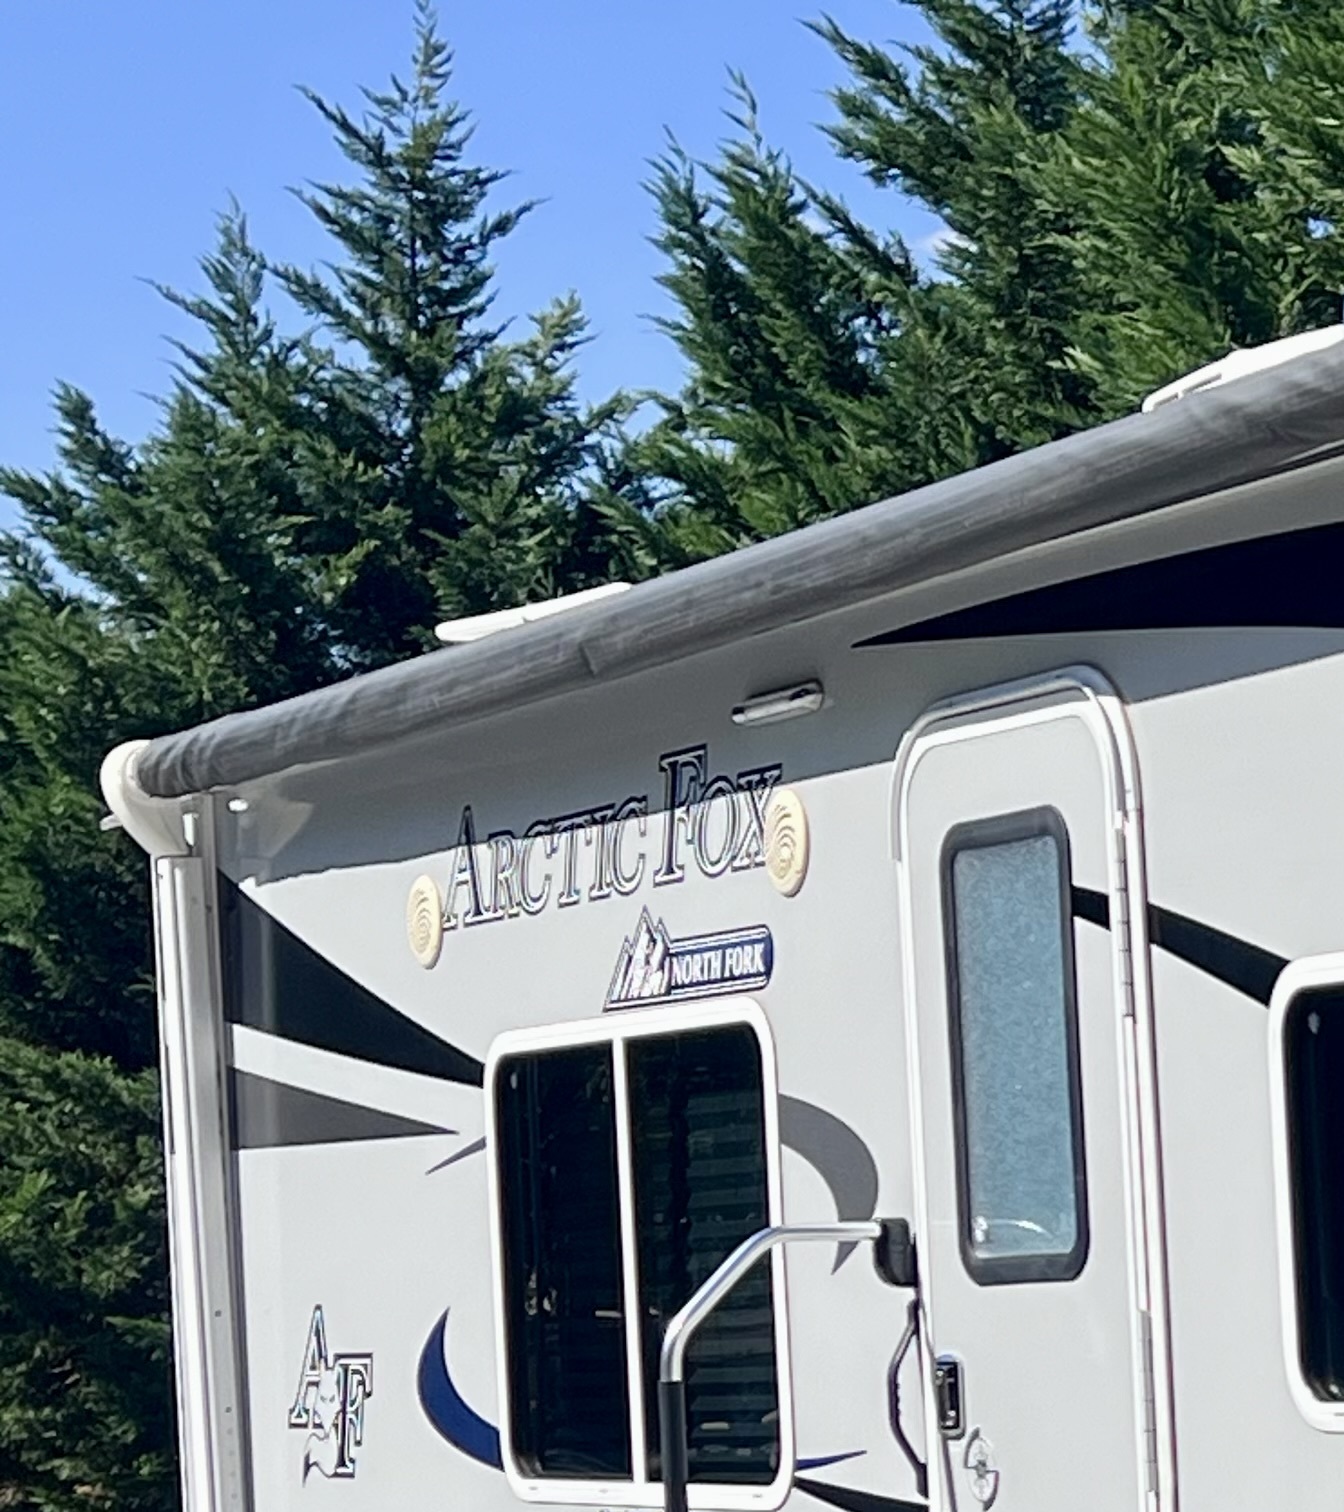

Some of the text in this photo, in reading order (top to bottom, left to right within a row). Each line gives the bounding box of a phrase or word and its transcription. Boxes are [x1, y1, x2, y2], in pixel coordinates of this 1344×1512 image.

[442, 743, 783, 931] ARCTIC FOX
[671, 942, 766, 986] NORTH FORK
